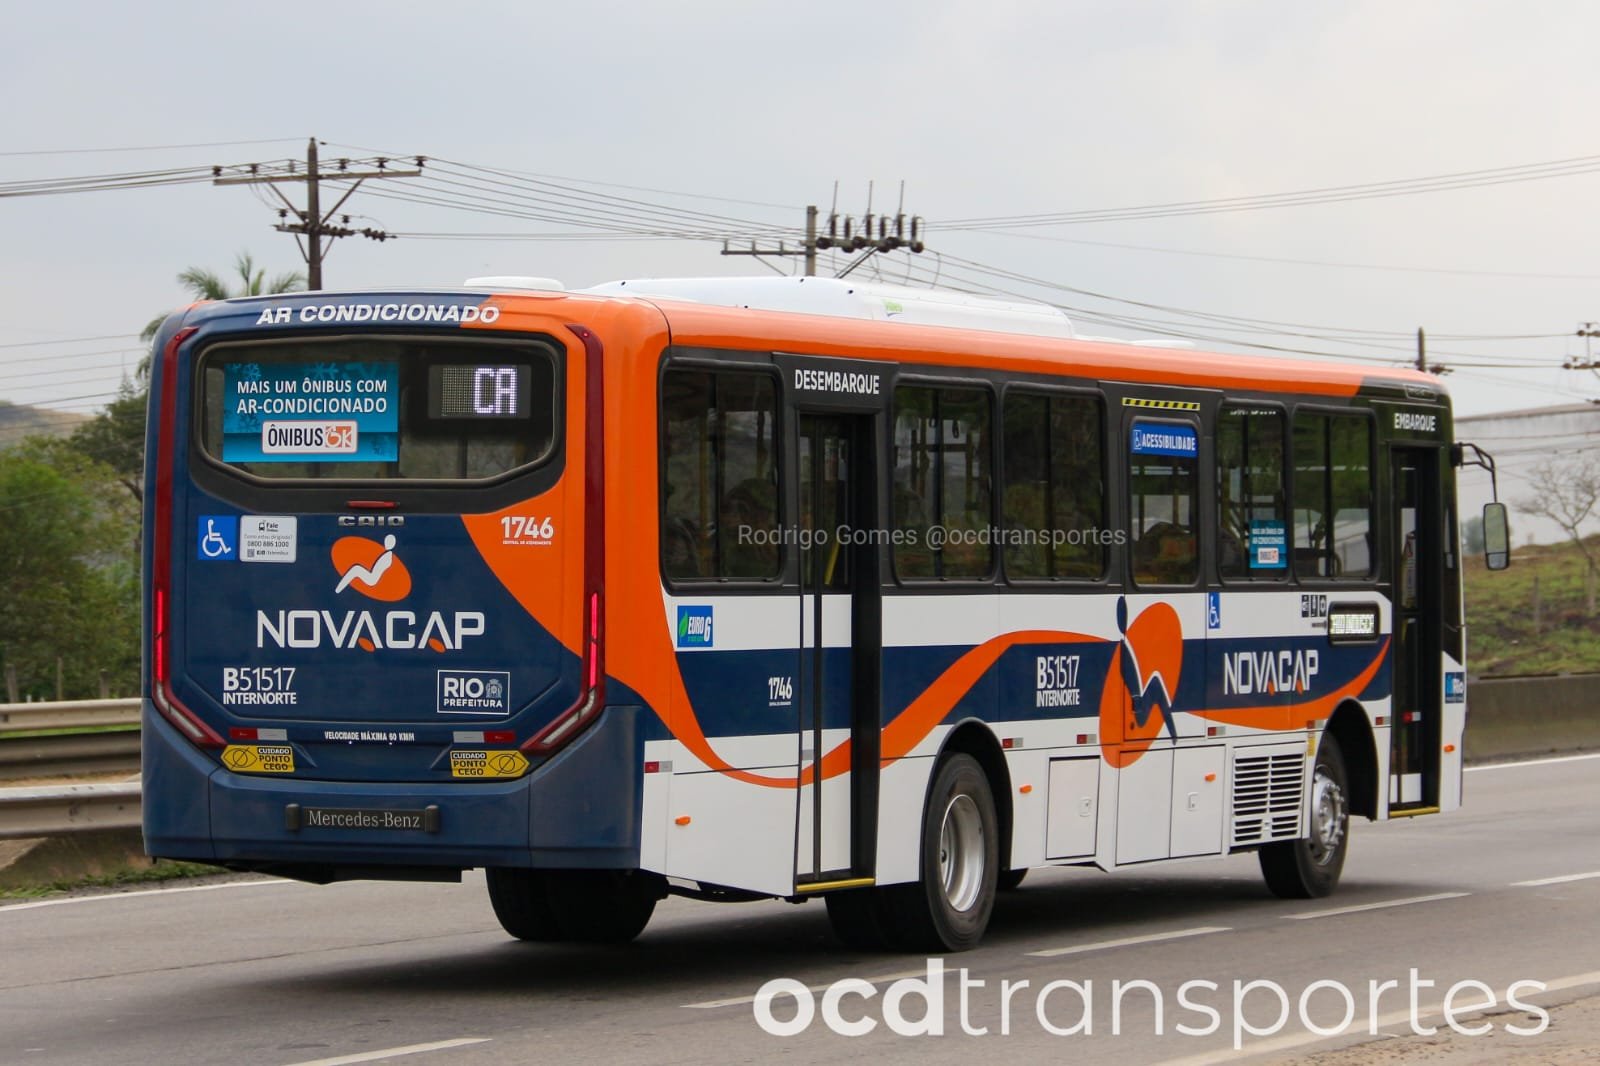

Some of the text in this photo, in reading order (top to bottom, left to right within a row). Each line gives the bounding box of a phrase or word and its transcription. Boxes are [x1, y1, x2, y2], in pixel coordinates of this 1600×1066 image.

[256, 304, 499, 325] AR CONDICIONADO
[237, 376, 387, 394] MAIS UM ÔNIBUS COM
[473, 367, 517, 416] CA
[794, 369, 880, 395] DESEMBARQUE
[236, 398, 387, 414] AR-CONDICIONADO
[1394, 413, 1436, 432] EMBARQUE
[268, 424, 323, 447] ÔNIBUS
[1142, 433, 1196, 451] ACESSIBILIDADE
[338, 516, 404, 527] CAIO
[501, 516, 554, 539] 1746
[257, 609, 485, 651] NOVACAP
[688, 616, 712, 642] EURO 6
[223, 667, 296, 691] B51517
[1037, 655, 1080, 689] B51517
[1224, 649, 1319, 695] NOVACAP
[444, 677, 484, 698] RIO
[768, 676, 793, 700] 1746
[223, 692, 297, 705] INTERNORTE
[443, 698, 503, 708] PREFEITURA
[1036, 689, 1080, 707] INTERNORTE
[324, 731, 359, 740] VELOCIDADE
[360, 731, 387, 741] MÁXIMA
[258, 755, 290, 763] PONTO
[263, 763, 288, 771] CEGO
[308, 810, 421, 829] Mercedes-Benz
